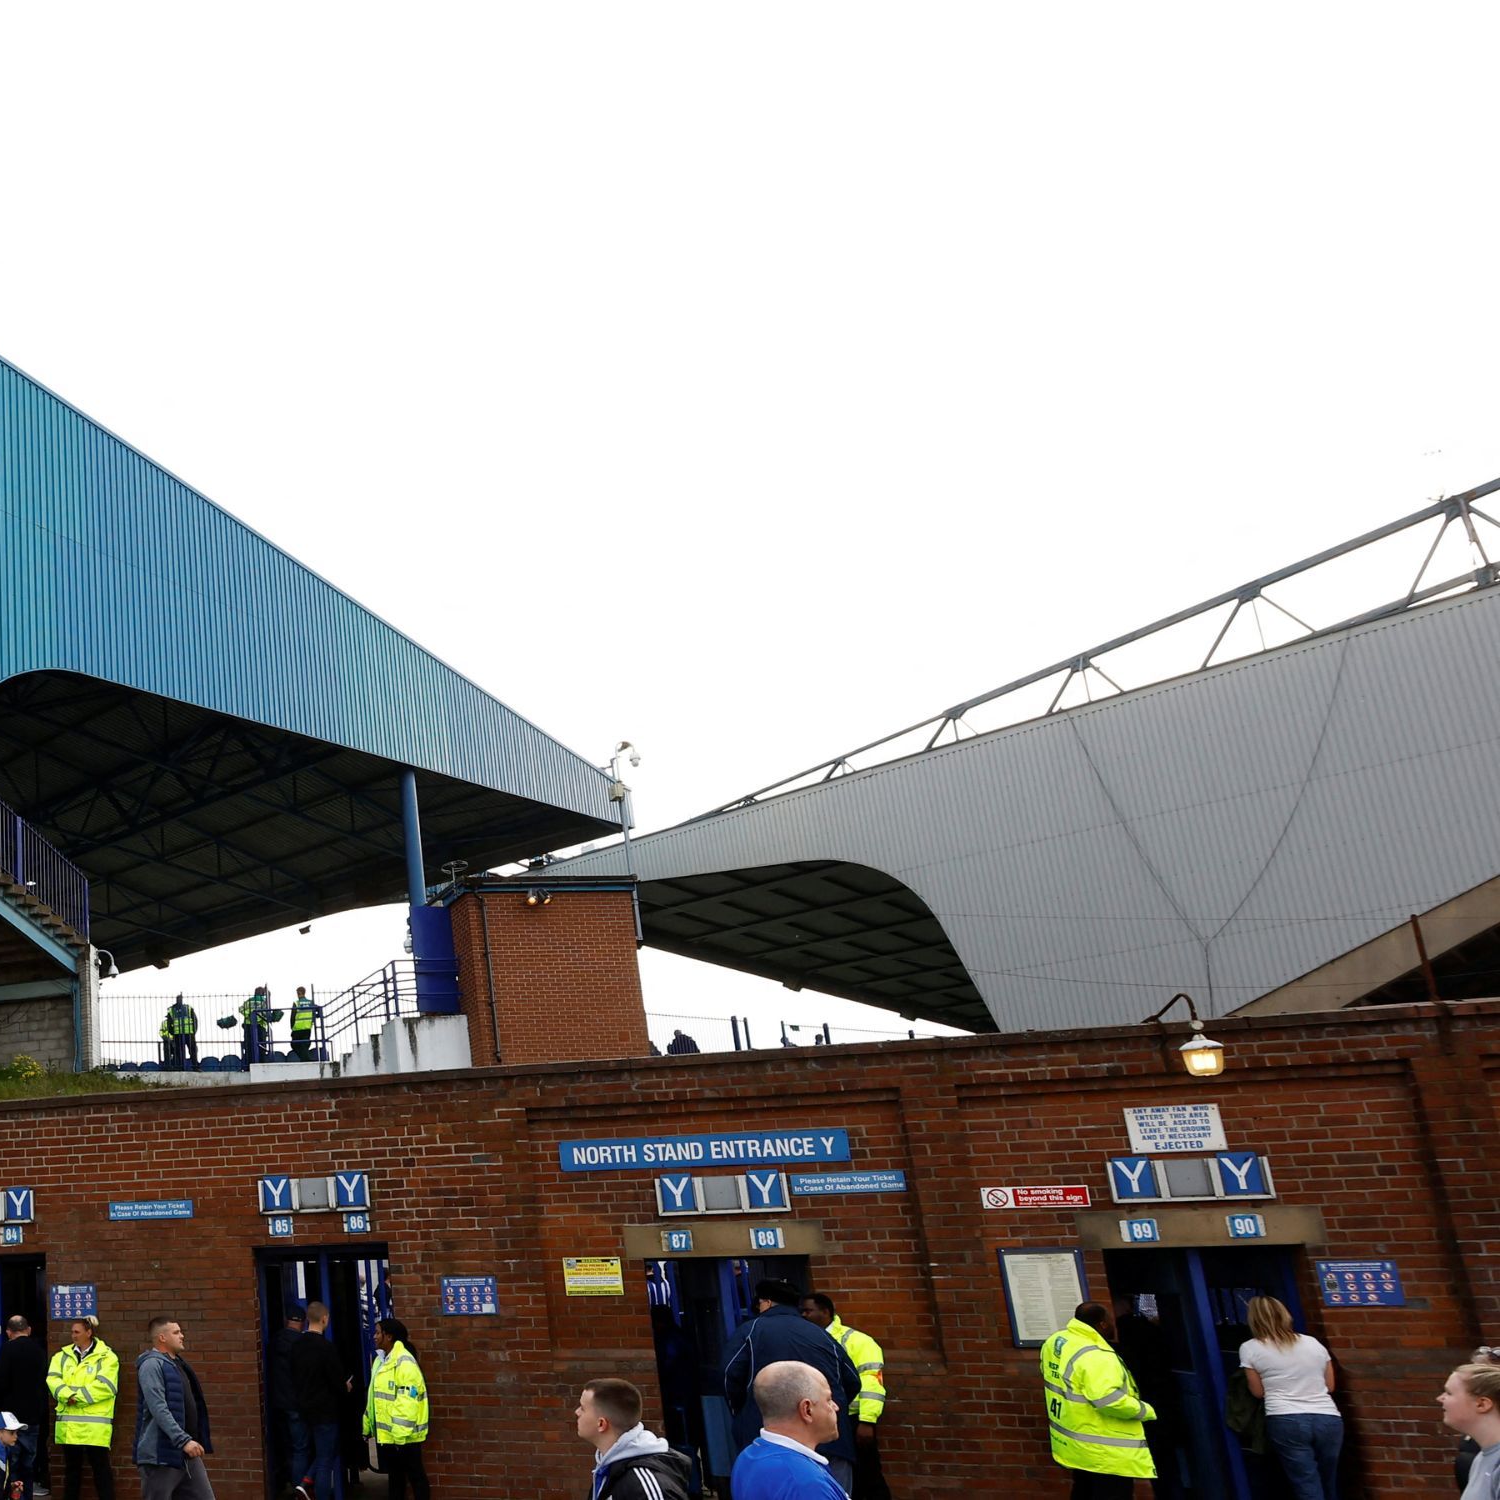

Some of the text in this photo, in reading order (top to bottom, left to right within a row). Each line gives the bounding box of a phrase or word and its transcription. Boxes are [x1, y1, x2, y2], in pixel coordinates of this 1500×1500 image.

[573, 1137, 835, 1165] NORTH STAND ENTRANCE Y
[1155, 1141, 1203, 1150] EJECTED
[1114, 1160, 1147, 1193] Y
[1220, 1158, 1253, 1190] Y
[264, 1179, 287, 1207] Y
[338, 1175, 361, 1202] Y
[662, 1177, 689, 1207] Y
[750, 1174, 777, 1204] Y
[8, 1190, 28, 1216] Y
[1066, 1194, 1083, 1202] sign
[276, 1220, 288, 1233] 85
[350, 1216, 364, 1230] 86
[1132, 1223, 1153, 1239] 89
[1234, 1218, 1256, 1235] 90
[6, 1229, 17, 1241] 84
[672, 1234, 687, 1249] 87
[758, 1232, 775, 1246] 88
